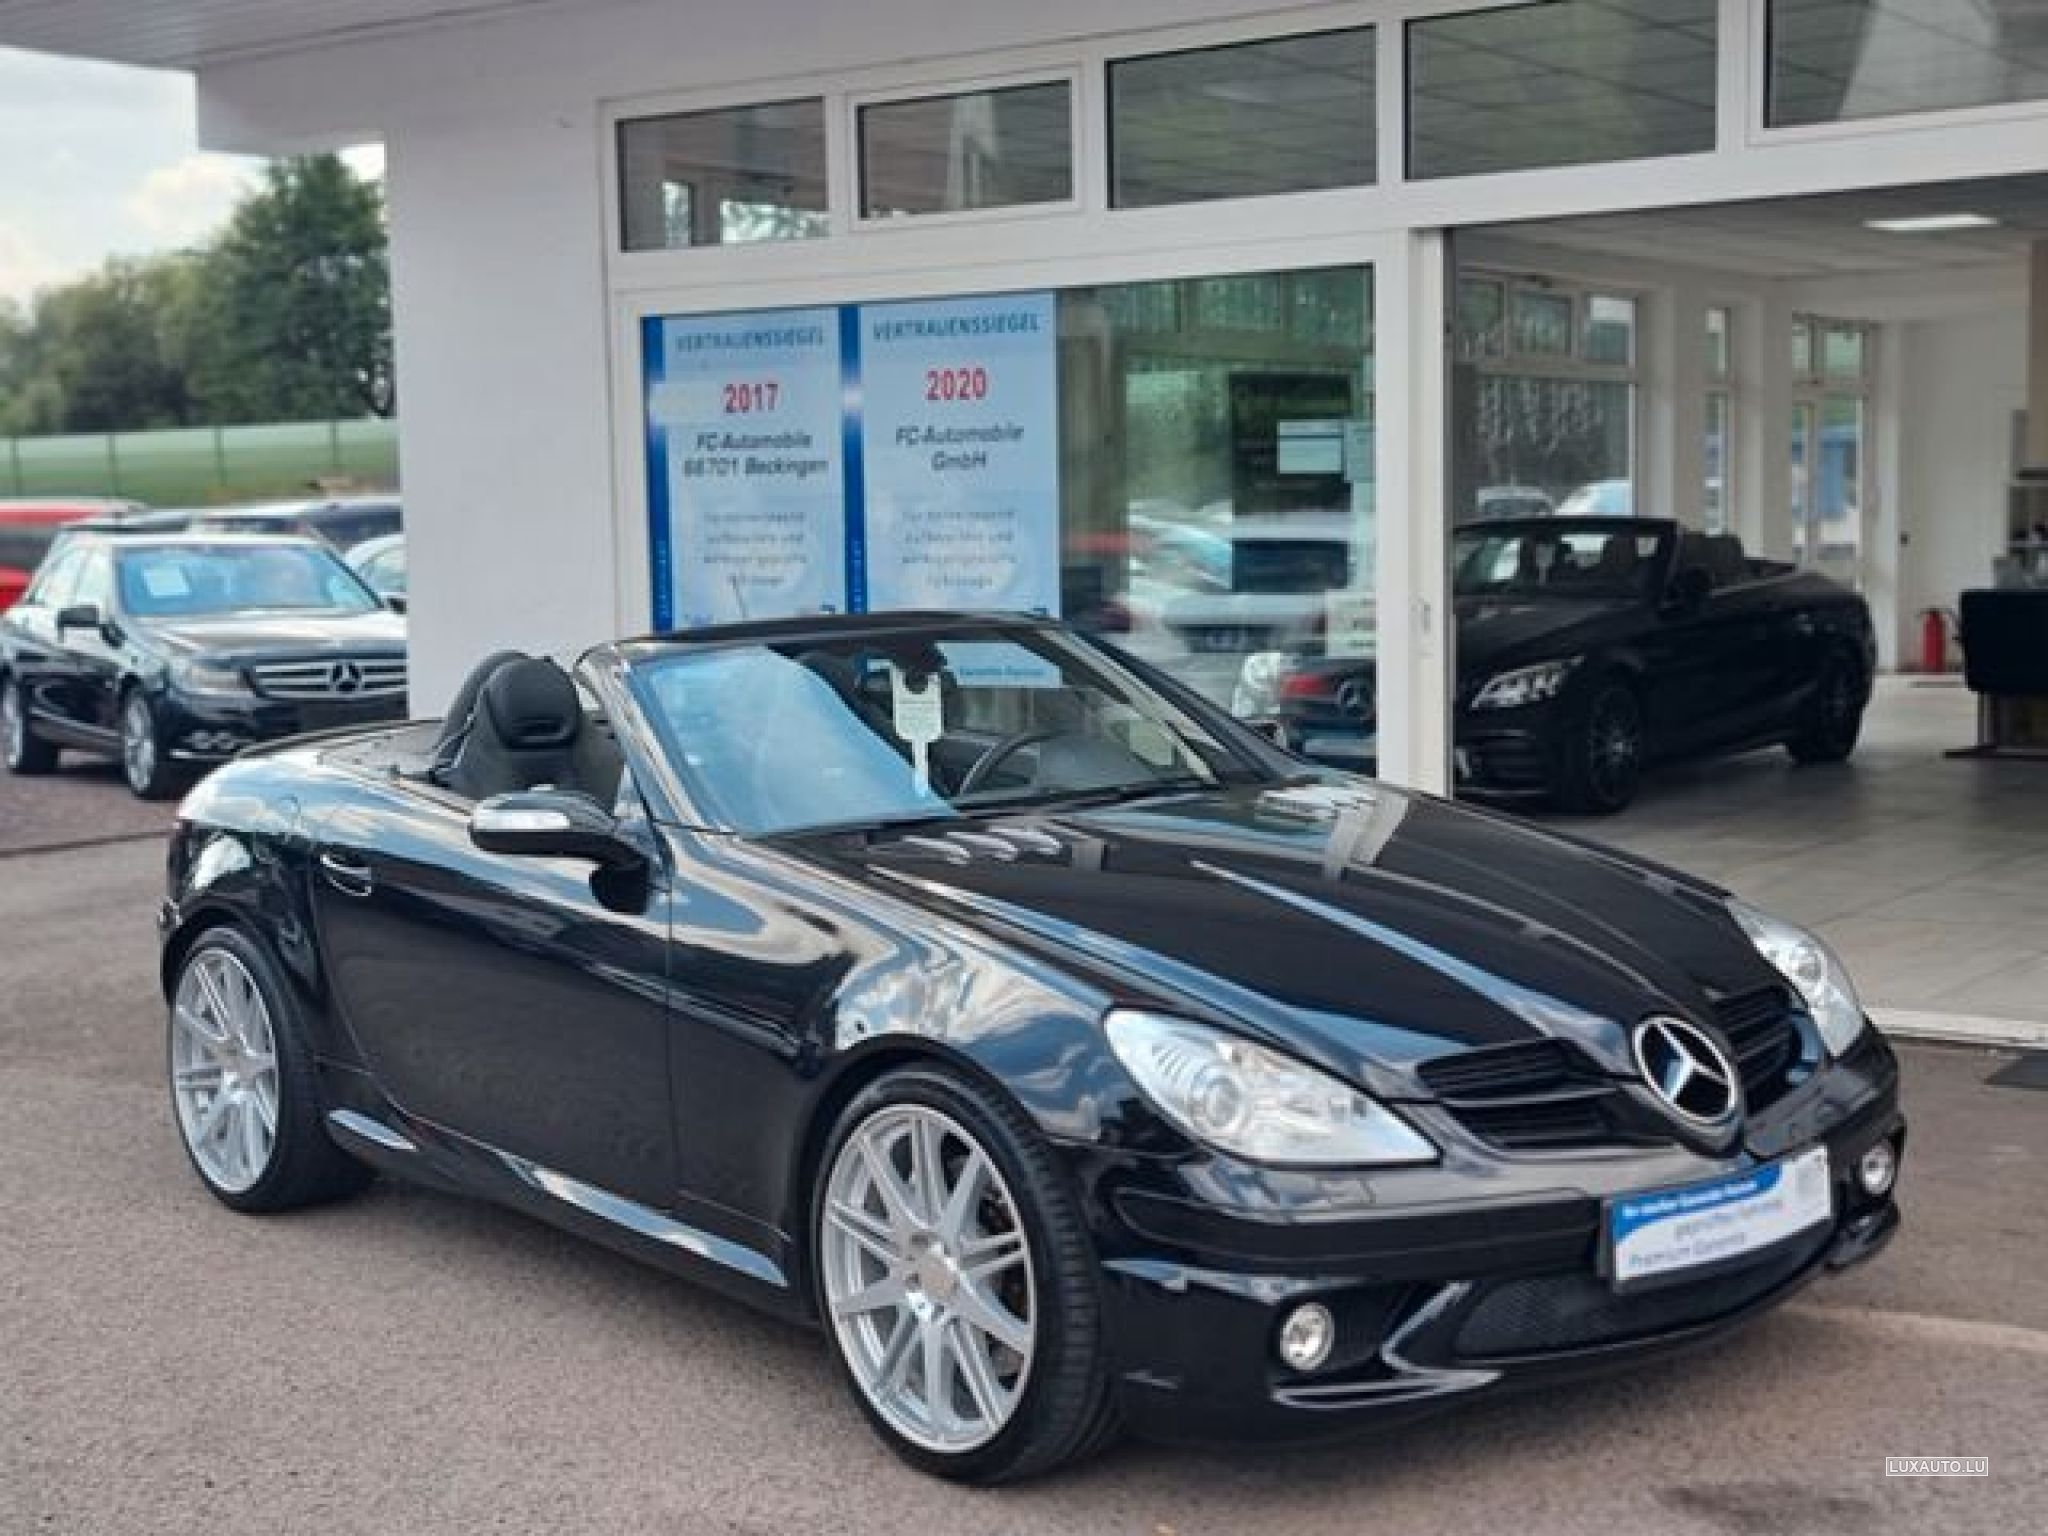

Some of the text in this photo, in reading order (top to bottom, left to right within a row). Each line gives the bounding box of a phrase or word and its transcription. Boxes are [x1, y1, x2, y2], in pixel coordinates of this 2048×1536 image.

[676, 327, 823, 352] VERTRAUENSSIEGEL
[873, 314, 1040, 341] VERTRAUENSSIEGEL
[926, 368, 987, 401] 2020
[724, 383, 778, 414] 2017
[931, 451, 987, 470] GmbH
